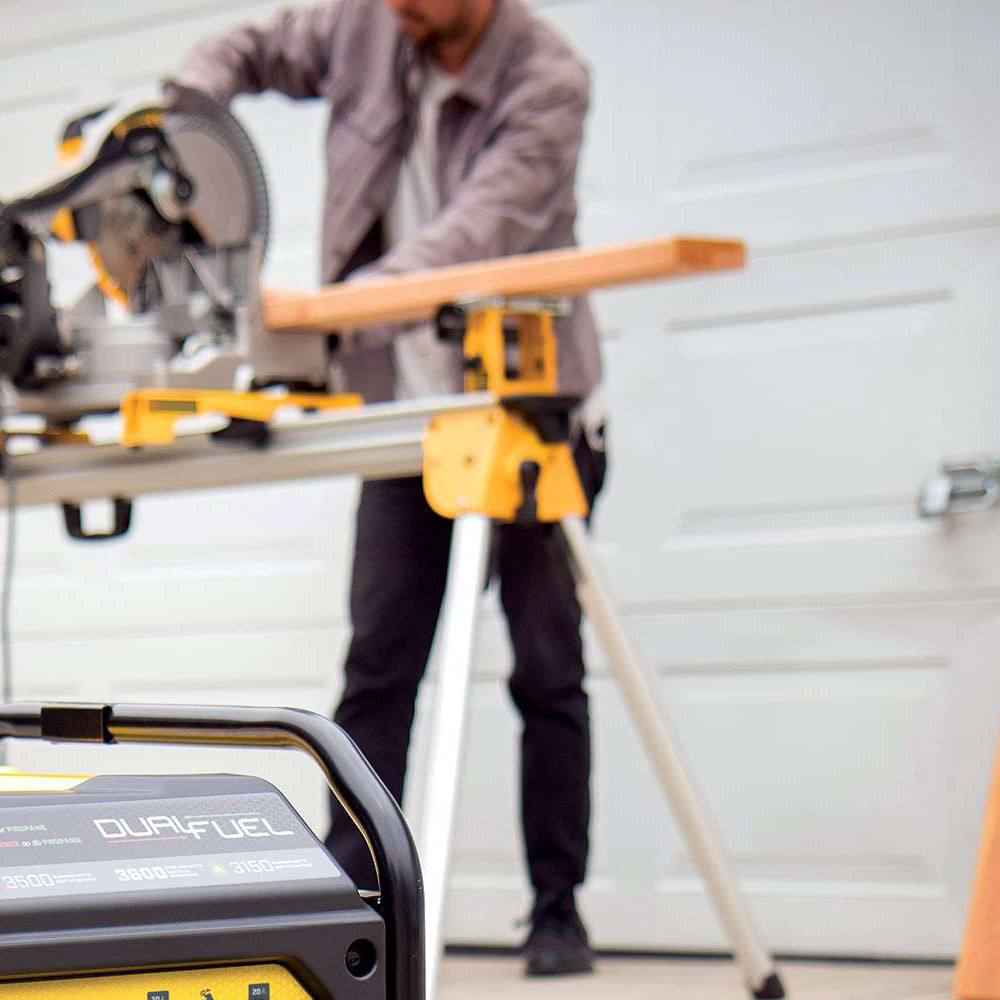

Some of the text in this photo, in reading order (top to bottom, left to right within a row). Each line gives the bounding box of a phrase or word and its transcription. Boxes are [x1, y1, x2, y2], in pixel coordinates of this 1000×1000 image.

[5, 824, 47, 833] PROPANE
[42, 837, 82, 846] PROPANE
[114, 865, 168, 882] 3600
[229, 859, 275, 874] 3150
[2, 873, 55, 889] 3500
